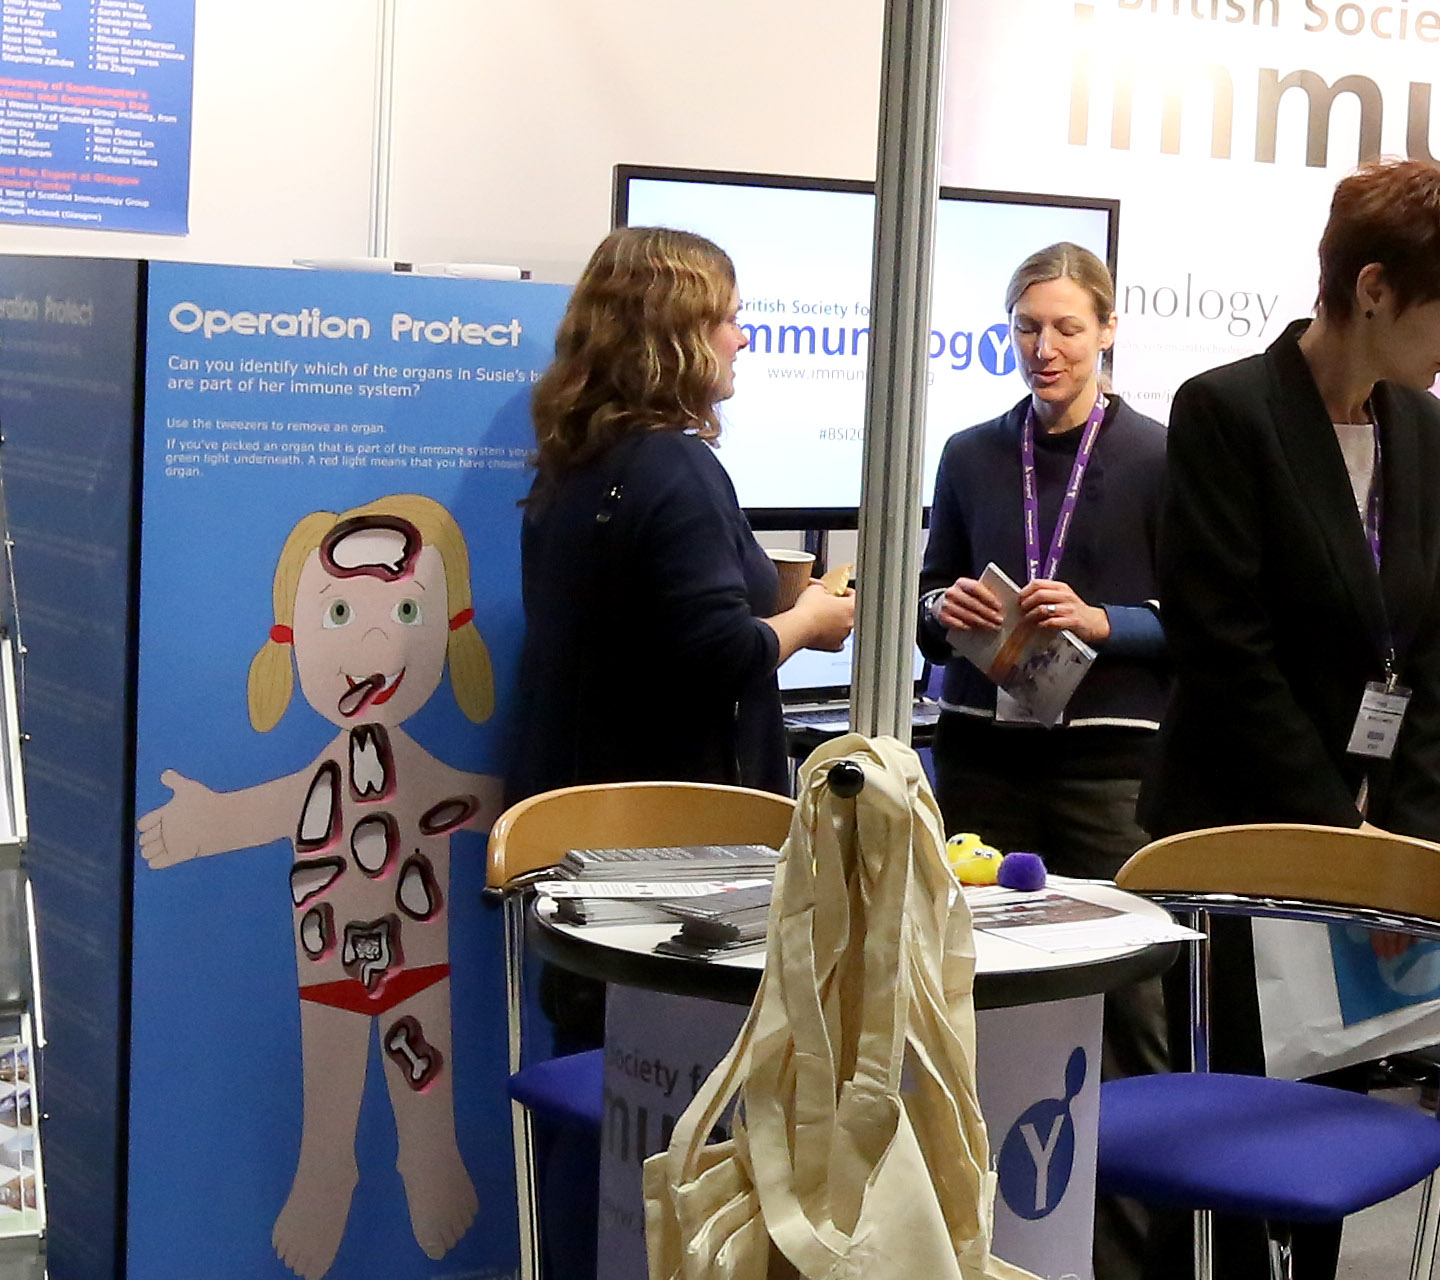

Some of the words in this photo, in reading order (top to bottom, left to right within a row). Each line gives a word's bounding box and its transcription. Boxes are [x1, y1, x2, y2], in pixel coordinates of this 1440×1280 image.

[793, 299, 847, 320] Society
[168, 301, 371, 339] Operation
[391, 312, 523, 347] Protect
[168, 355, 199, 371] Can
[205, 359, 233, 376] you
[240, 357, 298, 377] identify
[303, 361, 348, 377] which
[353, 363, 369, 377] of
[374, 364, 397, 378] the
[402, 367, 452, 383] organs
[458, 367, 471, 380] in
[476, 367, 525, 383] Susie's
[168, 377, 193, 390] are
[200, 377, 232, 395] part
[239, 377, 254, 391] of
[259, 379, 283, 392] her
[290, 380, 353, 395] immune
[358, 381, 420, 398] system?
[167, 417, 189, 429] Use
[193, 418, 212, 429] the
[216, 419, 268, 430] tweezers
[272, 420, 284, 431] to
[287, 422, 330, 433] remove
[334, 423, 348, 433] an
[352, 423, 386, 435] organ.
[166, 439, 175, 450] If
[222, 440, 259, 453] picked
[264, 441, 277, 452] an
[281, 441, 314, 454] organ
[318, 442, 341, 453] that
[345, 442, 354, 453] is
[358, 444, 381, 456] part
[385, 443, 396, 454] of
[399, 444, 416, 455] the
[420, 445, 463, 456] immune
[165, 454, 200, 464] green
[204, 453, 230, 464] light
[234, 454, 304, 465] underneath.
[308, 456, 316, 465] A
[320, 456, 338, 466] red
[342, 456, 367, 468] light
[371, 458, 407, 467] means
[411, 457, 432, 468] that
[436, 459, 456, 470] you
